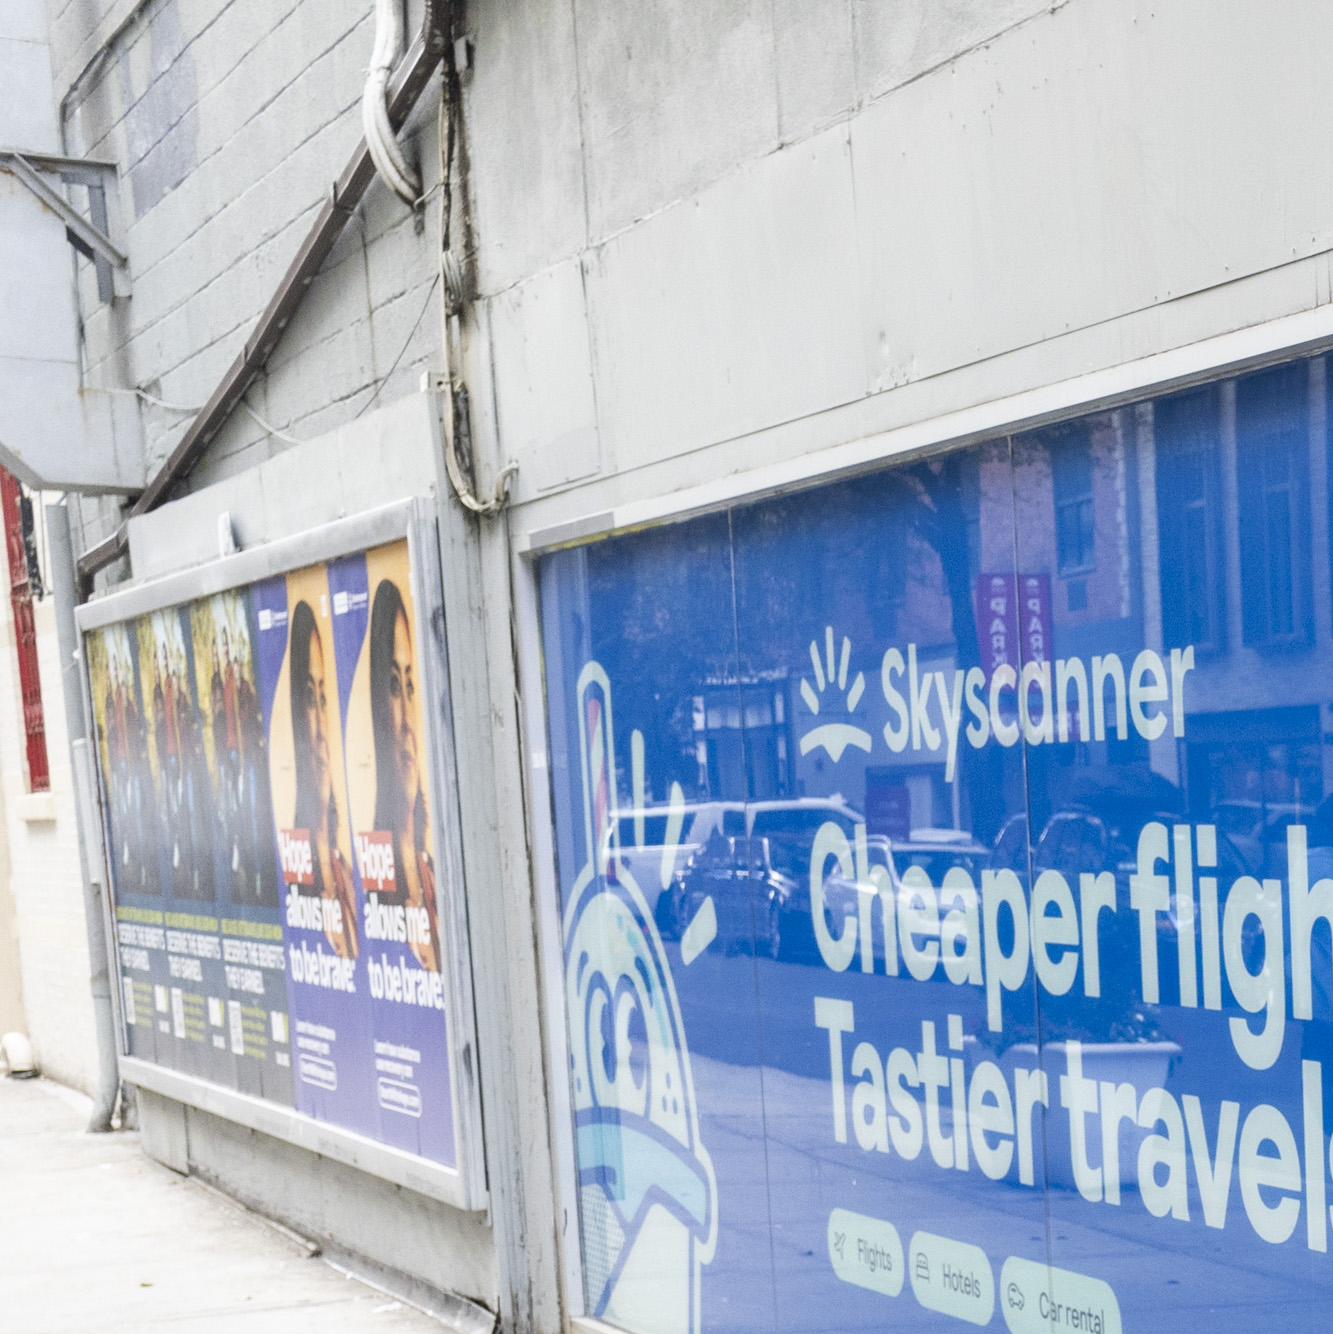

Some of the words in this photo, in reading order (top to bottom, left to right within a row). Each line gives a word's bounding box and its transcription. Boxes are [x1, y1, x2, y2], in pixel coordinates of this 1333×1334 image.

[881, 644, 1193, 782] Skyscanner
[285, 884, 322, 931] allows
[322, 899, 343, 934] me
[364, 892, 406, 943] allows
[406, 907, 431, 945] me
[810, 822, 1116, 1033] Cheaper
[289, 943, 303, 982] to
[302, 940, 319, 985] be
[368, 956, 383, 999] to
[382, 953, 401, 1003] be
[814, 997, 1047, 1185] Tastier
[857, 1238, 893, 1273] Flights
[943, 1263, 981, 1299] Hotels
[1039, 1291, 1063, 1323] Car
